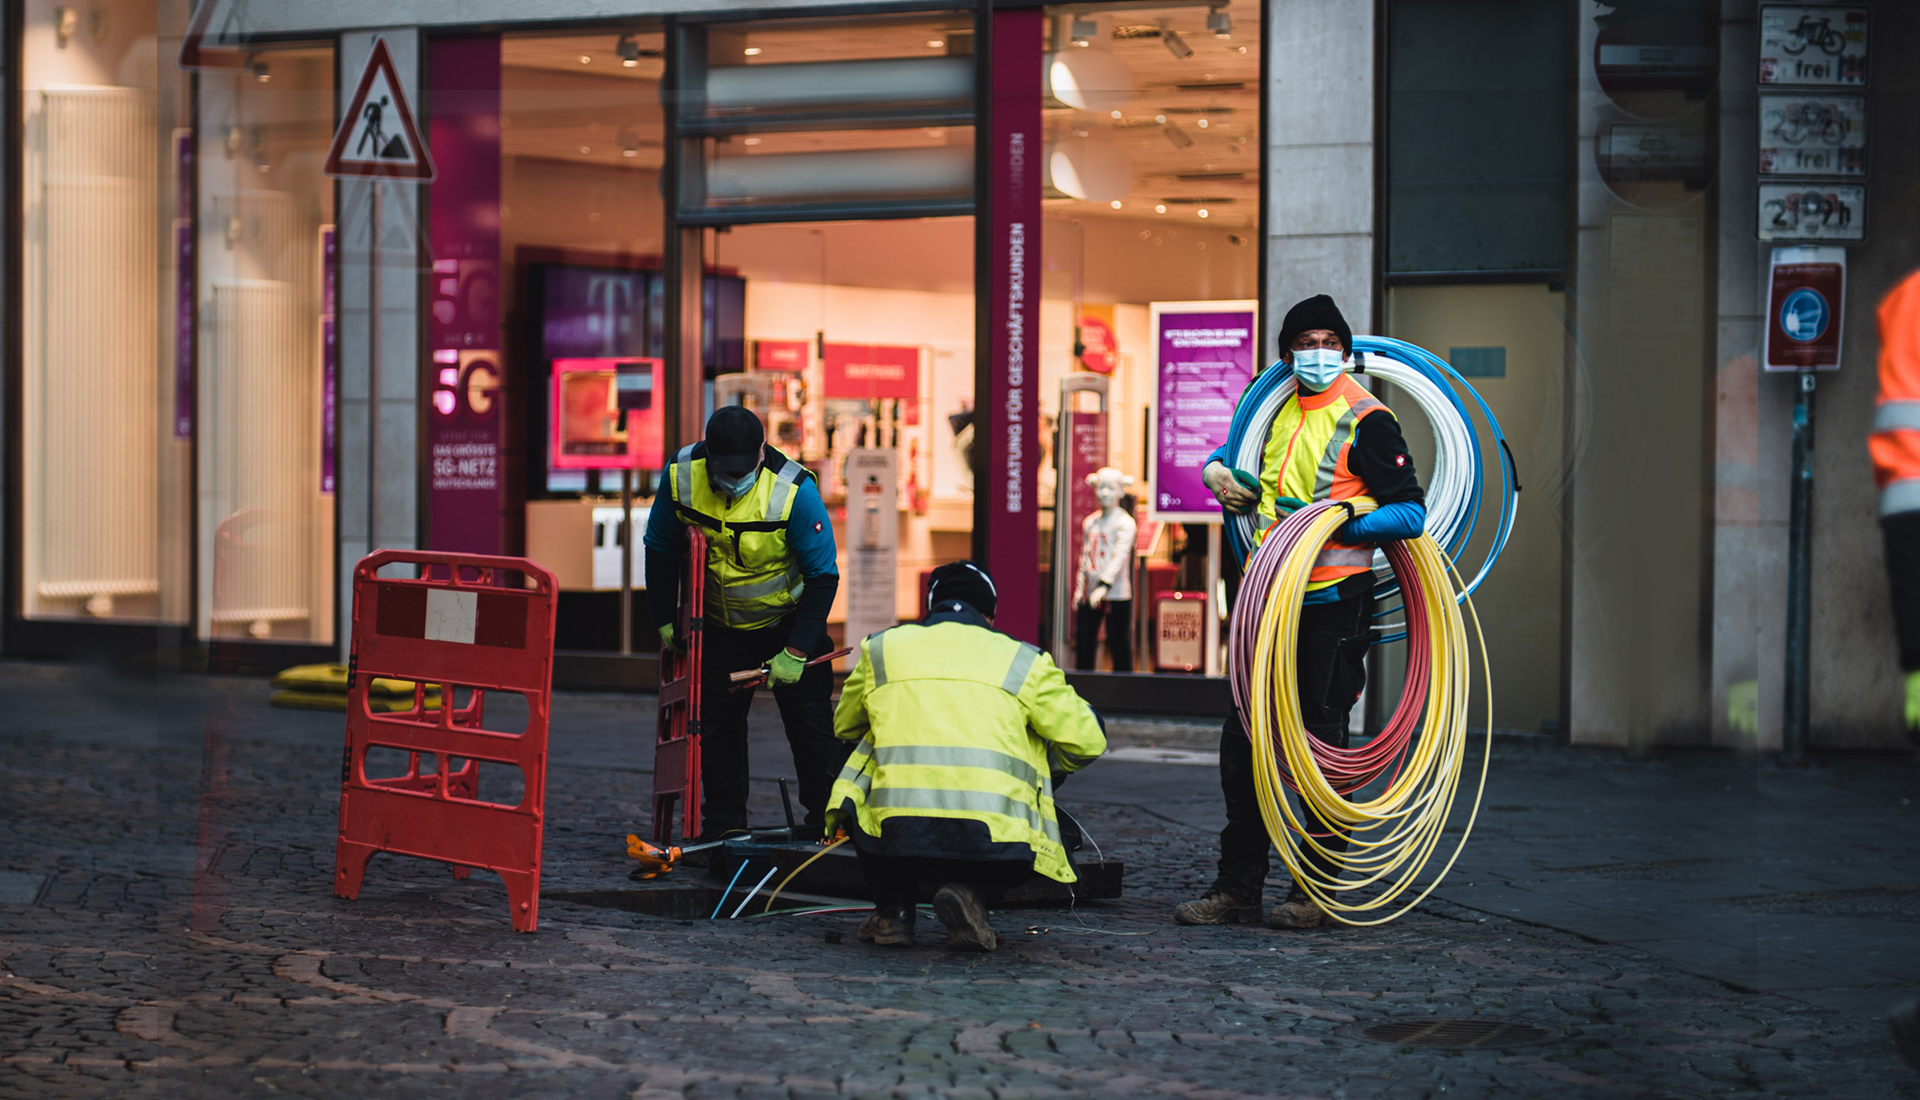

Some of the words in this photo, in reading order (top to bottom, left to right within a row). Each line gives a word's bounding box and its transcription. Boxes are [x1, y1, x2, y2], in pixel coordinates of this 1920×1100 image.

[1795, 58, 1831, 79] frei
[1796, 148, 1831, 169] frei
[1005, 222, 1025, 387] GESCHÄFTSKUNDEN
[431, 357, 499, 424] 5G
[1004, 388, 1023, 422] FÜR
[432, 443, 453, 457] DAS
[453, 441, 497, 458] GRÖSSTE
[433, 457, 497, 478] 5G-NETZ
[1006, 424, 1023, 513] BERATUNG
